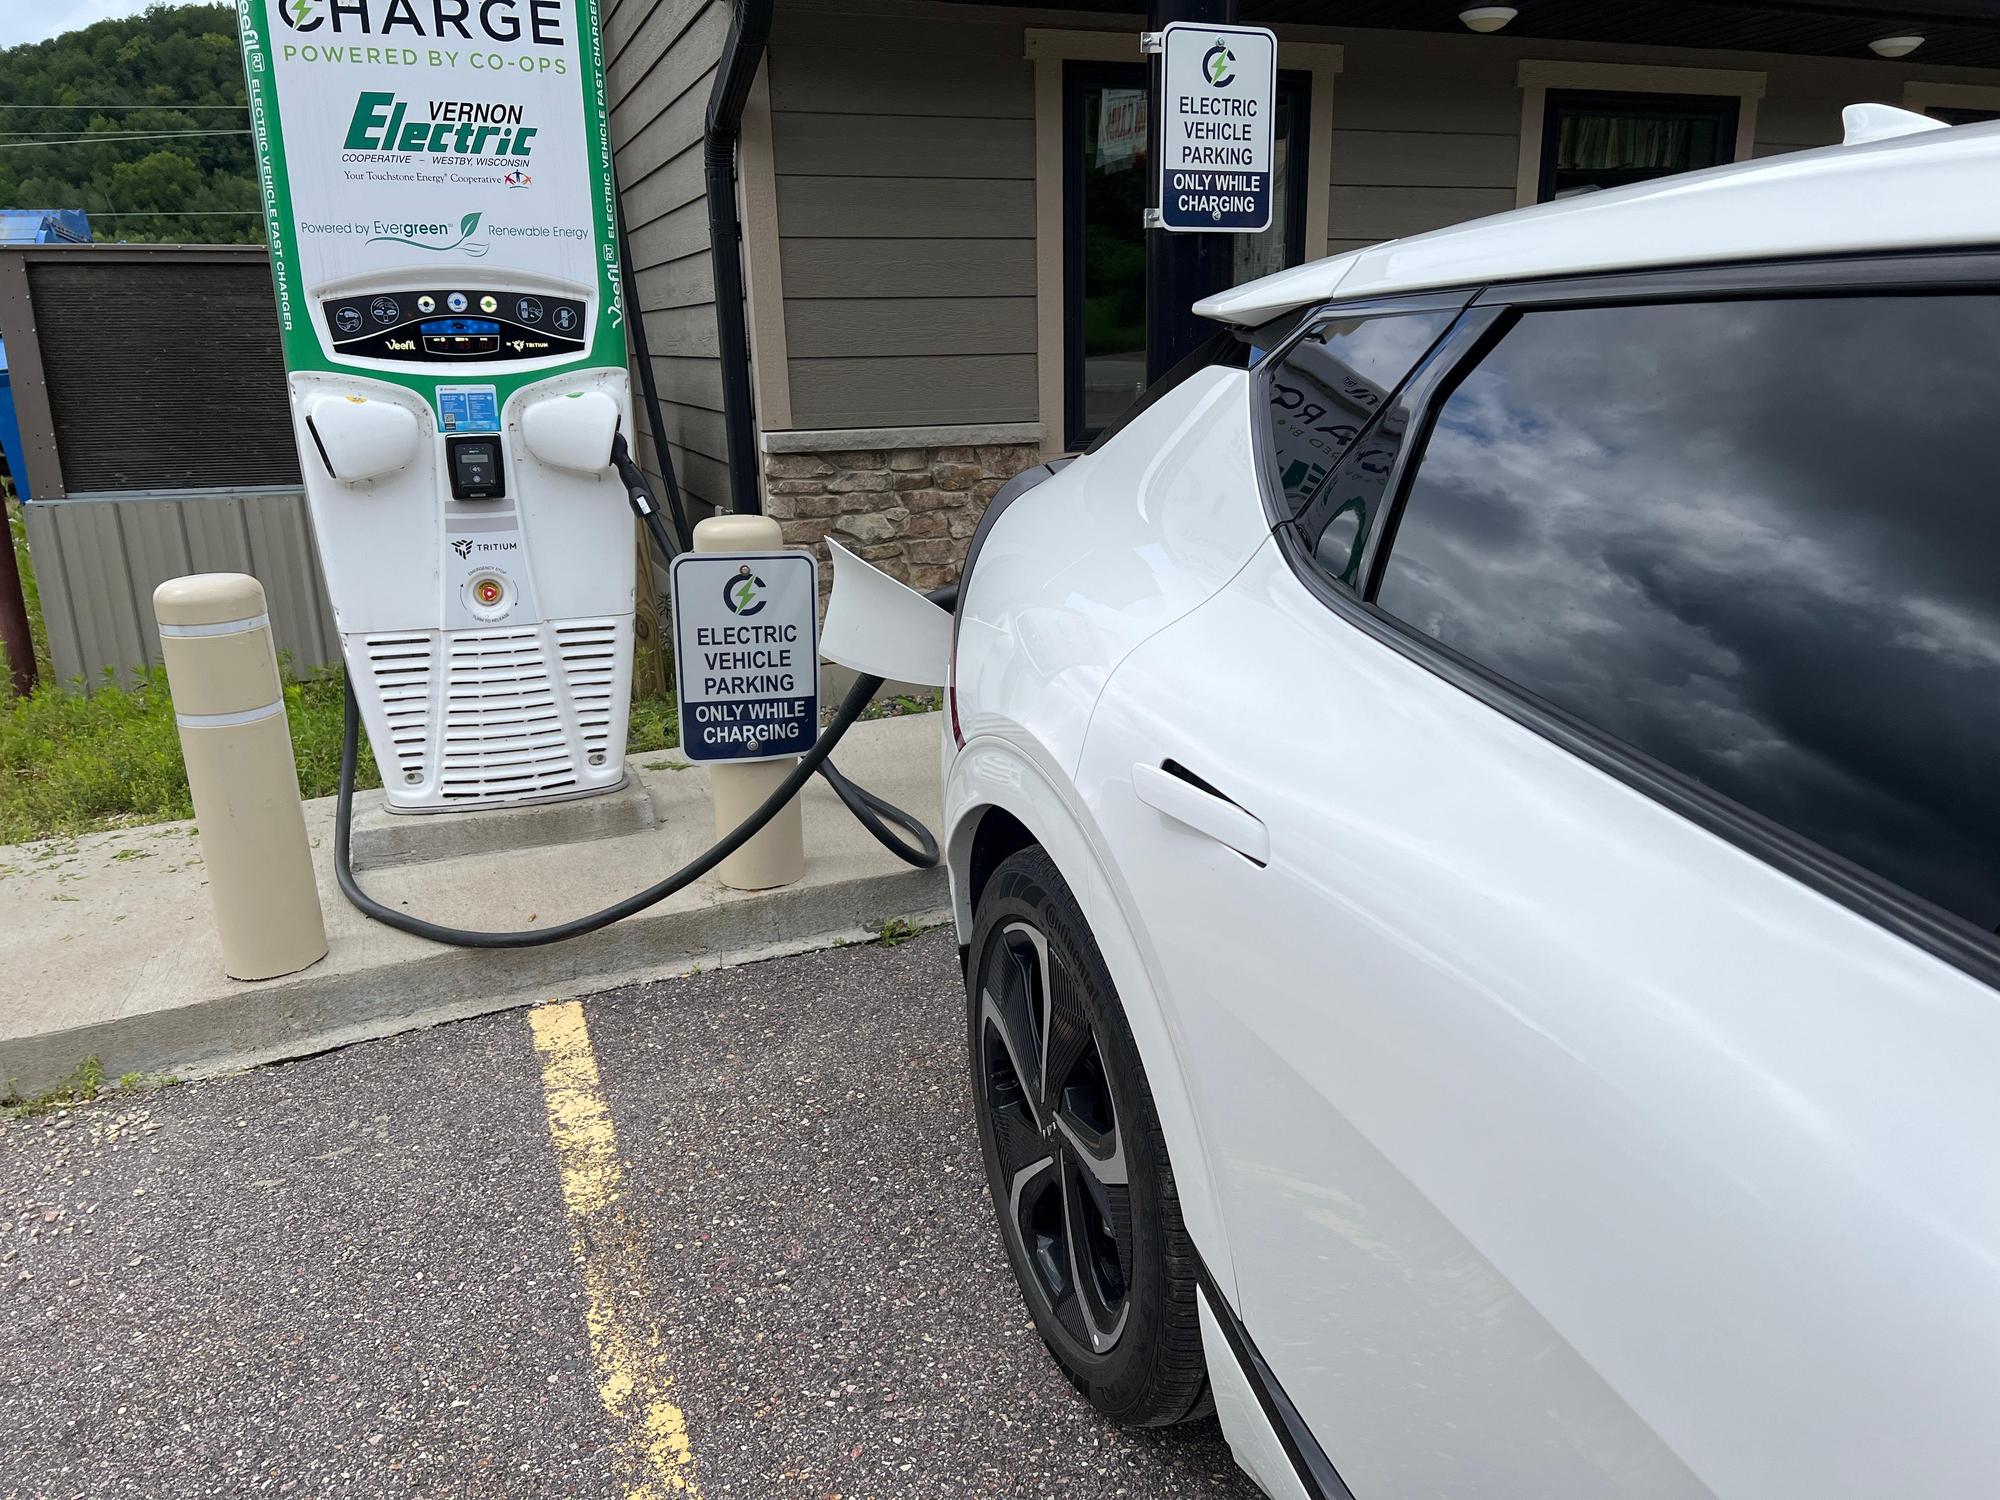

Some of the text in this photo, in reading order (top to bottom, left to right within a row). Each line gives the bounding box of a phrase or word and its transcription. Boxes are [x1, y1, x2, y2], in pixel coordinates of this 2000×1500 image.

[239, 0, 260, 55] eefil
[278, 0, 565, 46] CHARGE
[283, 45, 567, 75] POWERED BY CO-OPS
[595, 73, 604, 106] FAST
[251, 79, 268, 151] ELECTRIC
[429, 101, 523, 124] VERNON
[1179, 96, 1257, 117] ELECTRIC
[343, 91, 538, 156] Electric
[1184, 121, 1252, 141] VEHICLE
[599, 111, 609, 169] VEHICLE
[341, 153, 412, 164] COOPERATIVE
[432, 157, 473, 166] WESTBY,
[476, 158, 530, 168] WISCONSIN
[1182, 146, 1253, 165] PARKING
[261, 156, 278, 217] VEHICLE
[344, 171, 364, 181] Your
[366, 171, 414, 181] Touchstone
[450, 173, 501, 185] Cooperative
[1173, 173, 1260, 192] ONLY WHILE
[604, 173, 615, 238] ELECTRIC
[1178, 195, 1255, 212] CHARGING
[271, 222, 283, 257] FAST
[301, 220, 588, 240] Powered by Evergreen Renewable Energy
[276, 261, 292, 331] CHARGER
[477, 543, 517, 551] TRITIUM
[697, 624, 797, 646] ELECTRIC
[704, 650, 791, 670] VEHICLE
[704, 673, 794, 695] PARKING
[695, 701, 805, 722] ONLY WHILE
[703, 722, 799, 744] CHARGING
